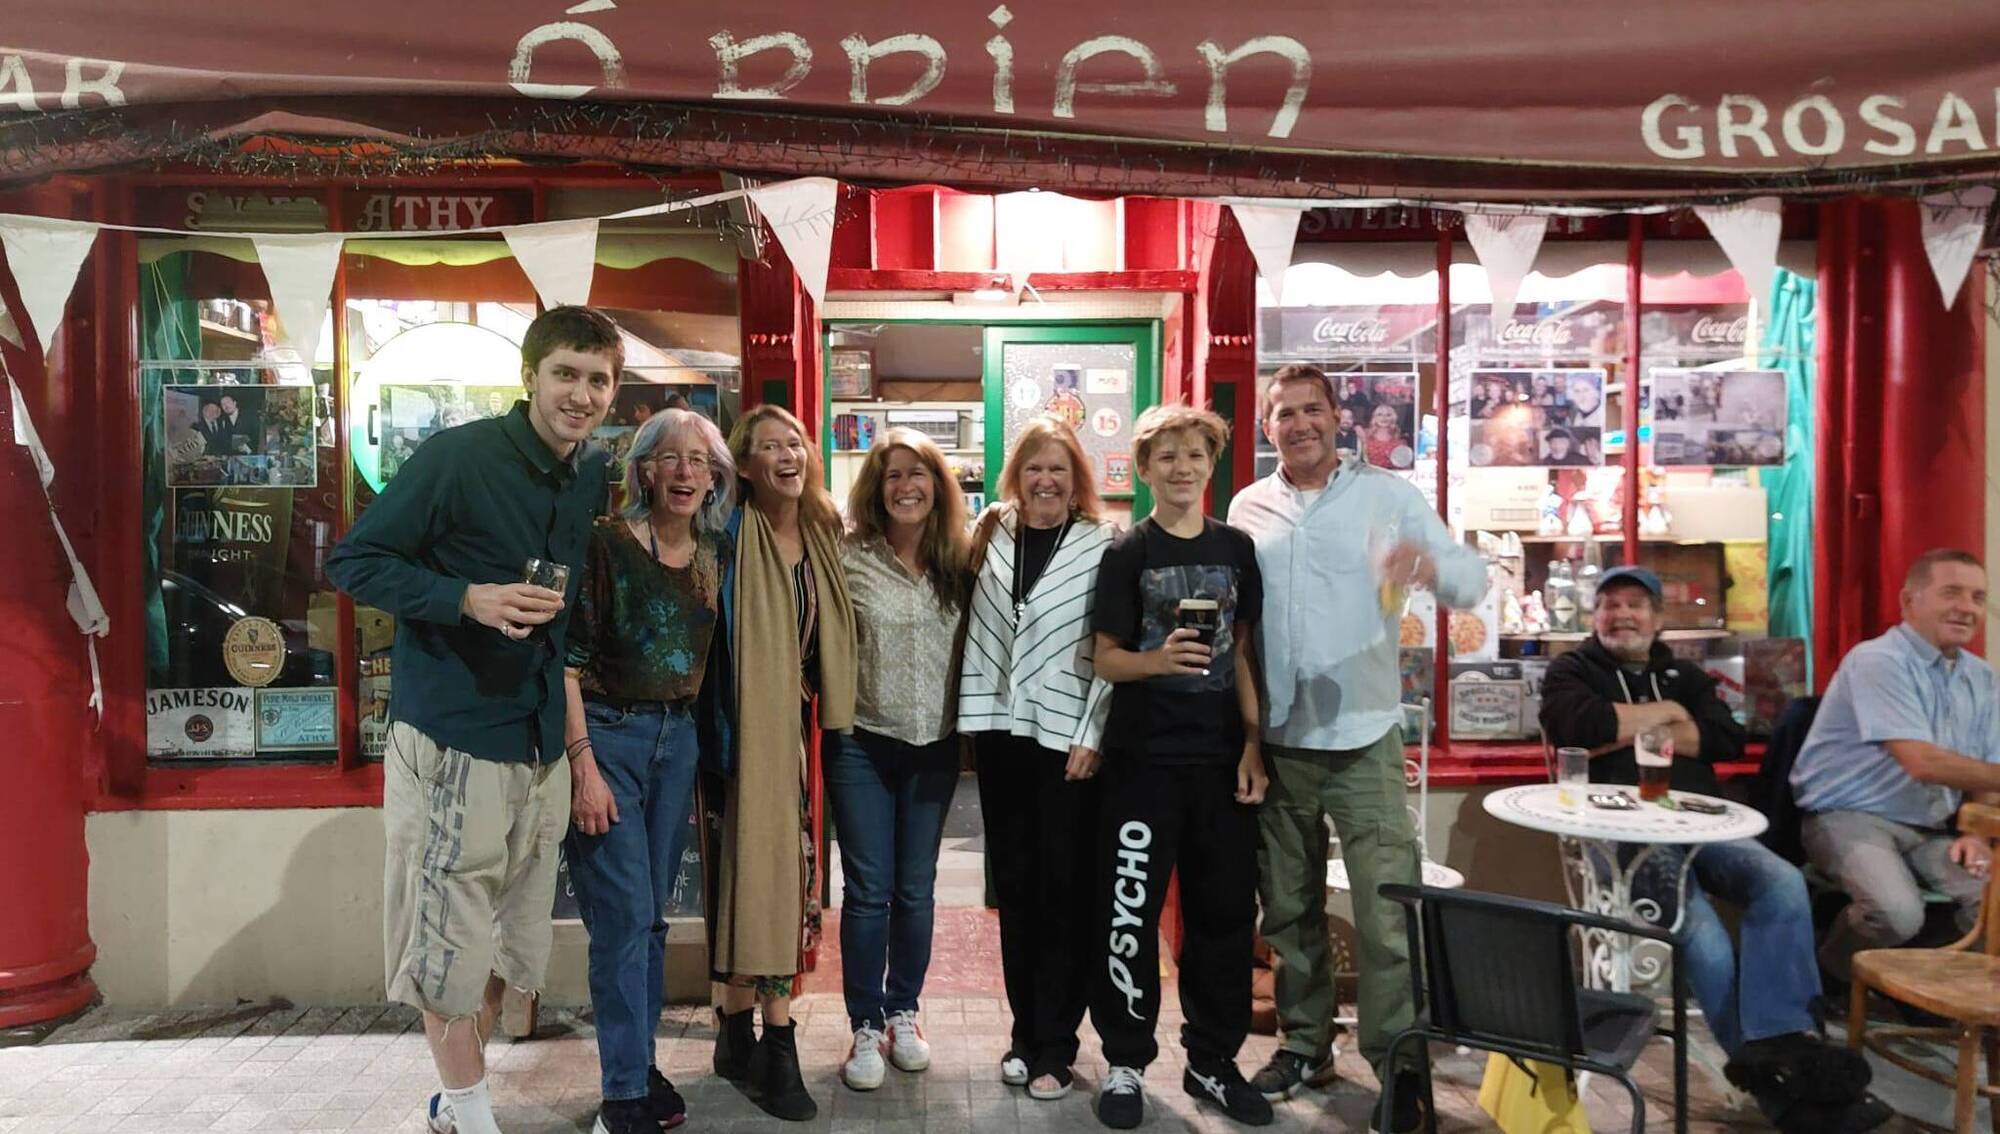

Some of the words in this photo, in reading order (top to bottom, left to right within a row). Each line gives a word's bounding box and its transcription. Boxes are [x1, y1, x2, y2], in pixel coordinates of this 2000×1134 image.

[1641, 76, 2000, 159] GRÓSA
[356, 194, 494, 231] ATHY
[1099, 414, 1119, 432] 15
[147, 689, 250, 716] JAMESON
[1108, 820, 1153, 1020] PSYCHO
